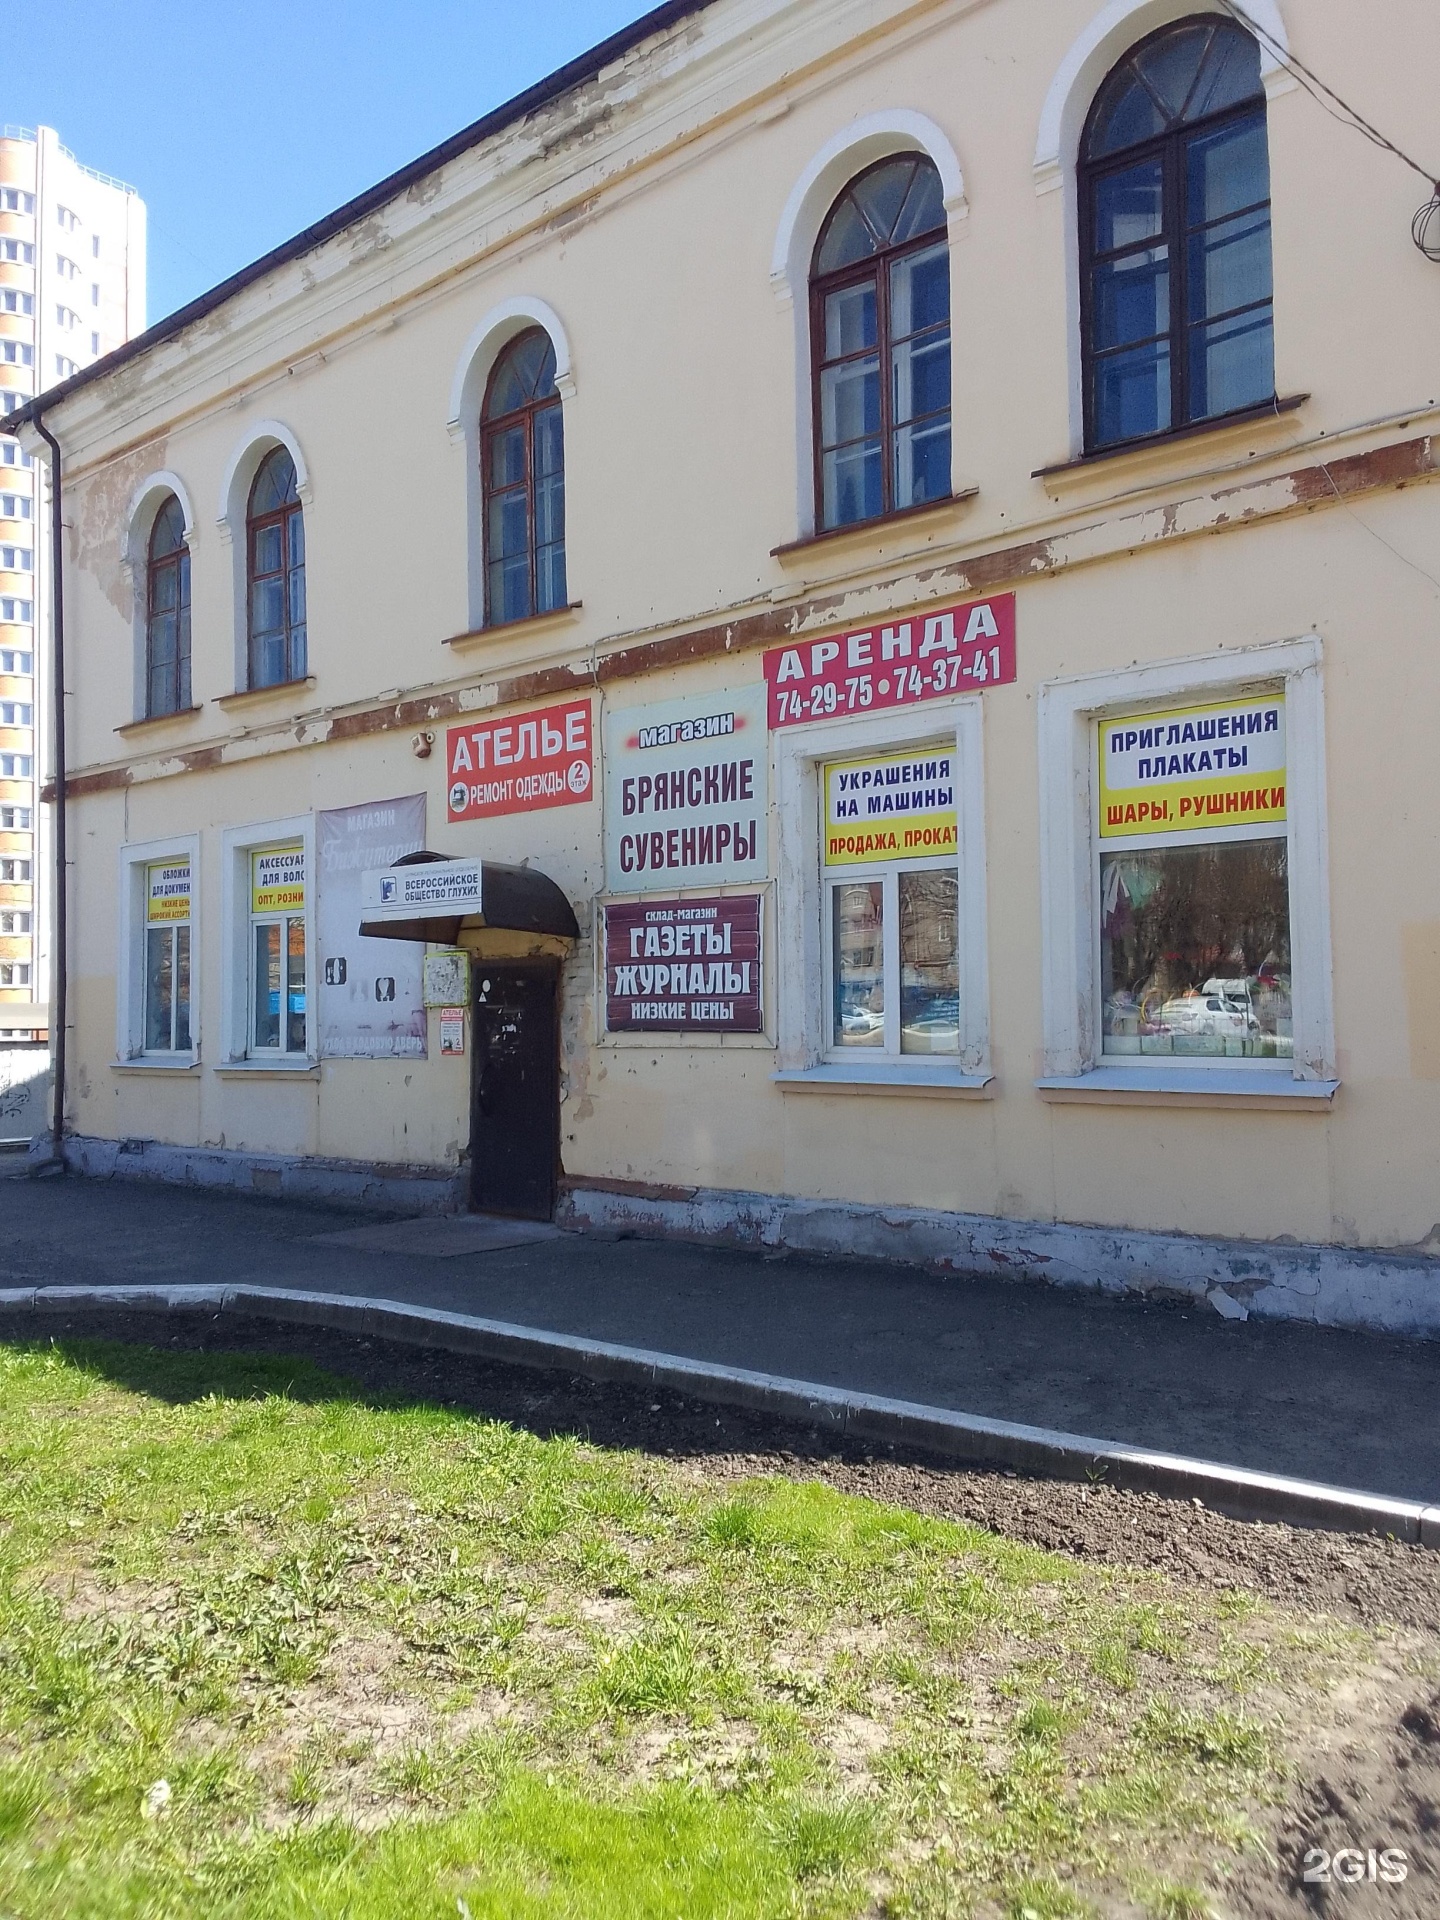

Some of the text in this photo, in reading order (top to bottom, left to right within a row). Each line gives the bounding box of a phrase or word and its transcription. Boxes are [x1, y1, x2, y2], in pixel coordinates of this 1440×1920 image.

[776, 604, 999, 684] АРЕНДА
[776, 646, 1000, 721] 74-29-75 74-37-41
[452, 711, 587, 773] АТЕЛЬЕ
[638, 713, 734, 749] магазин
[1111, 710, 1278, 752] ПРИГЛАШЕНИЯ
[574, 762, 584, 779] 2
[838, 759, 950, 792] УКРАШЕНИЯ
[1138, 745, 1248, 779] ПЛАКАТЫ
[470, 769, 566, 806] РЕМОНТ ОДЕЖДЫ
[622, 759, 754, 816] БРЯНСКИЕ
[836, 786, 953, 818] НА МАШИНЫ
[347, 809, 395, 832] МАГАЗИН
[1107, 786, 1286, 826] ШАРЫ, РУШНИКИ
[619, 820, 757, 873] СУВЕНИРЫ
[829, 825, 958, 856] ПРОДАЖА, ПРОКАТ
[162, 867, 191, 880] ОБЛОЖКИ
[262, 873, 280, 887] ДЛЯ
[405, 873, 478, 890] ВСЕРОССИЙСКОЕ
[152, 885, 164, 898] ДЛЯ
[257, 891, 304, 906] ОПТ, РОЗНИ
[404, 885, 478, 902] ОБЩЕСТВО ГЛУХИХ
[645, 907, 718, 922] склад-магазин
[630, 922, 732, 958] ГАЗЕТЫ
[613, 962, 751, 996] ЖУРНАЛЫ
[631, 1001, 734, 1020] НИЗКИЕ ЦЕНЫ
